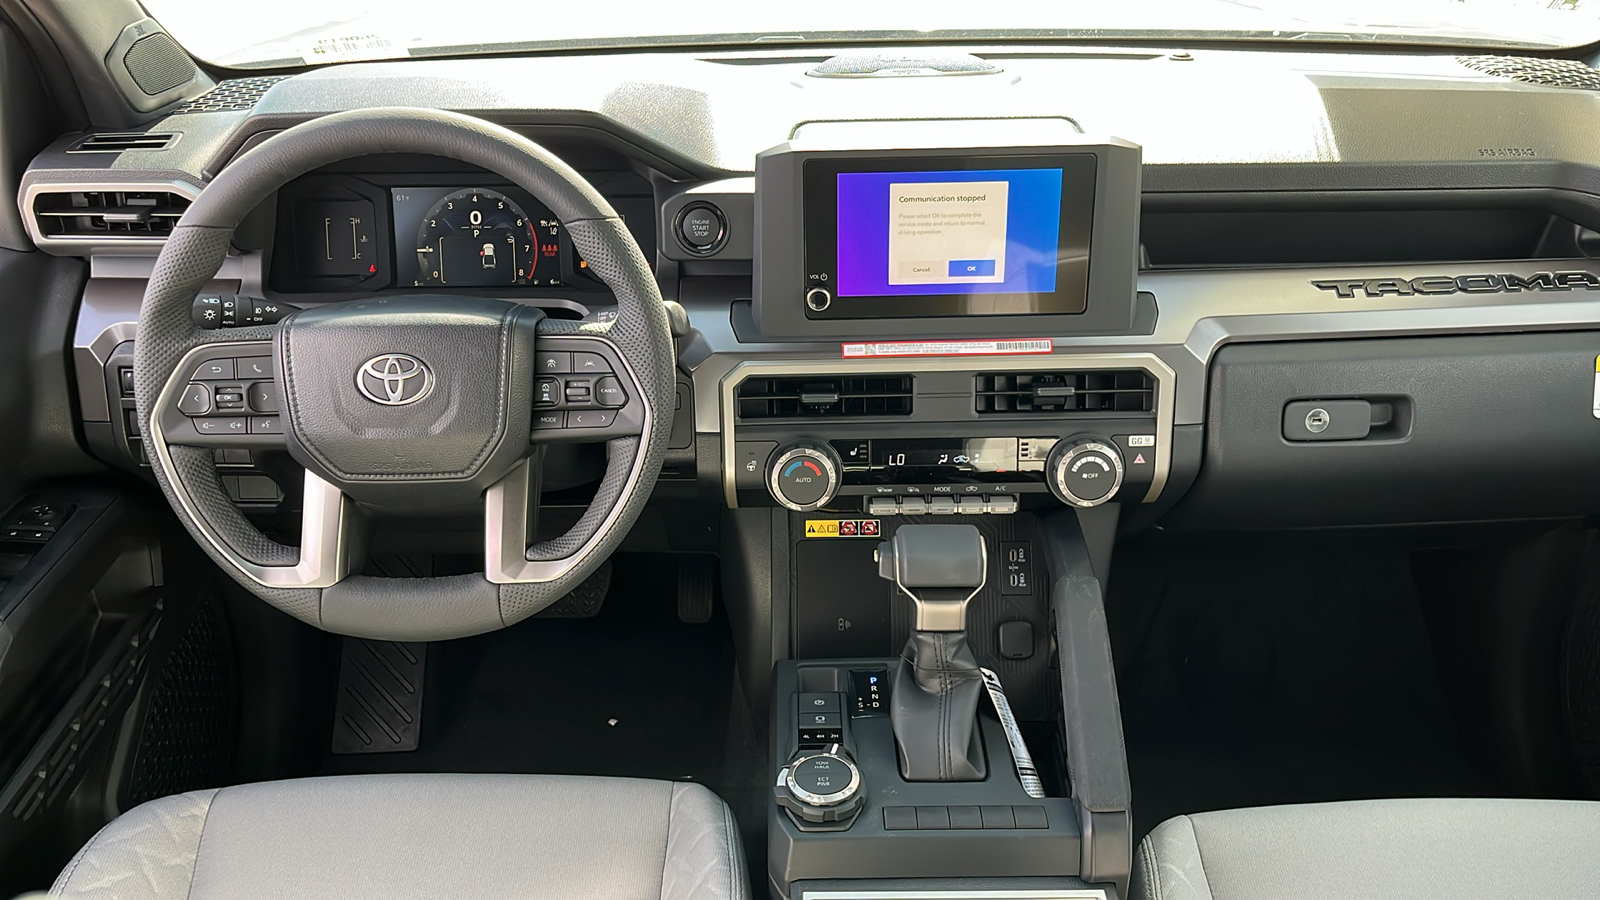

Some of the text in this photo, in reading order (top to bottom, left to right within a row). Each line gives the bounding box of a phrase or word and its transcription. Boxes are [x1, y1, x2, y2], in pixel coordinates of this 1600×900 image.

[1478, 148, 1536, 157] SRS AIRBAG
[472, 195, 478, 203] 4
[898, 194, 986, 203] Communication stopped
[447, 202, 454, 210] 3
[469, 210, 482, 225] 0
[430, 219, 437, 227] 2
[473, 229, 480, 238] P
[433, 270, 439, 278] 0
[1307, 270, 1600, 299] TACOMA
[1131, 437, 1143, 445] GG
[888, 453, 906, 466] LO
[870, 676, 877, 684] P
